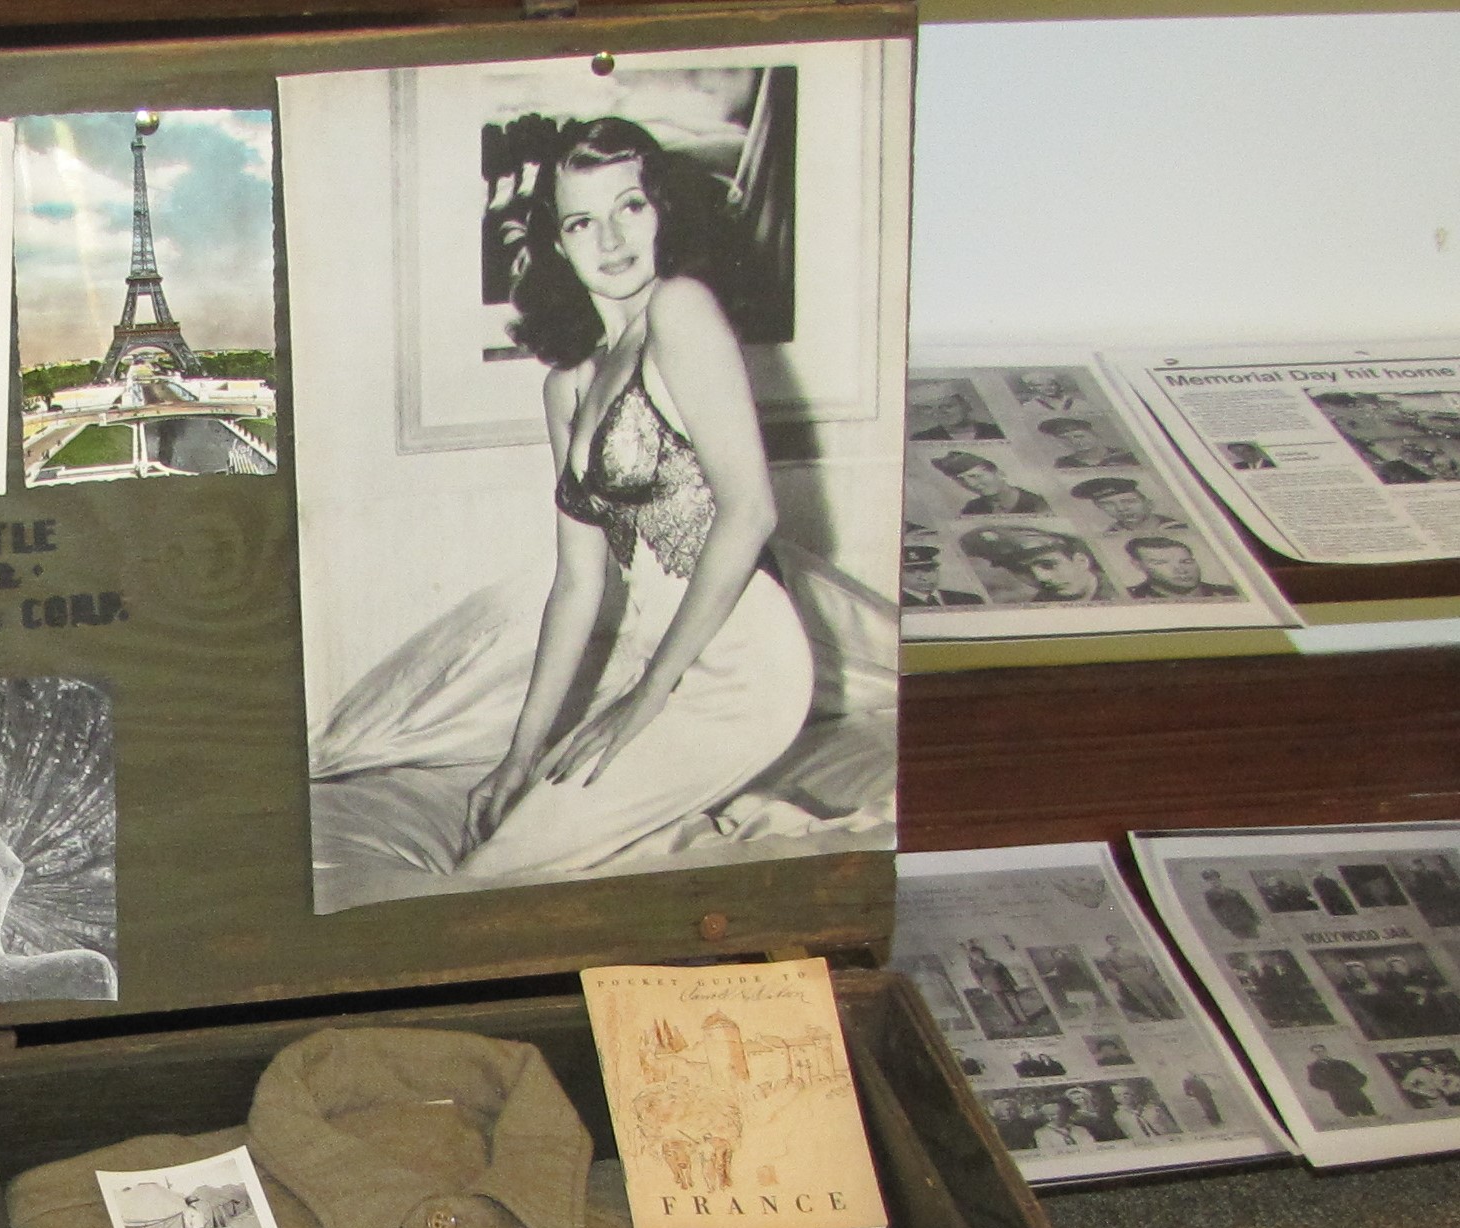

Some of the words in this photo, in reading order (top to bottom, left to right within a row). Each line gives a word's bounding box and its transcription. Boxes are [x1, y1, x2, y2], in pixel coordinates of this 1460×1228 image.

[1165, 371, 1283, 388] Memorial
[1290, 368, 1338, 384] Day
[1344, 367, 1380, 380] hit
[1382, 365, 1455, 380] home
[596, 977, 677, 988] POCKET
[697, 974, 762, 987] GUIDE
[783, 970, 806, 982] TO
[659, 1190, 848, 1216] FRANCE
